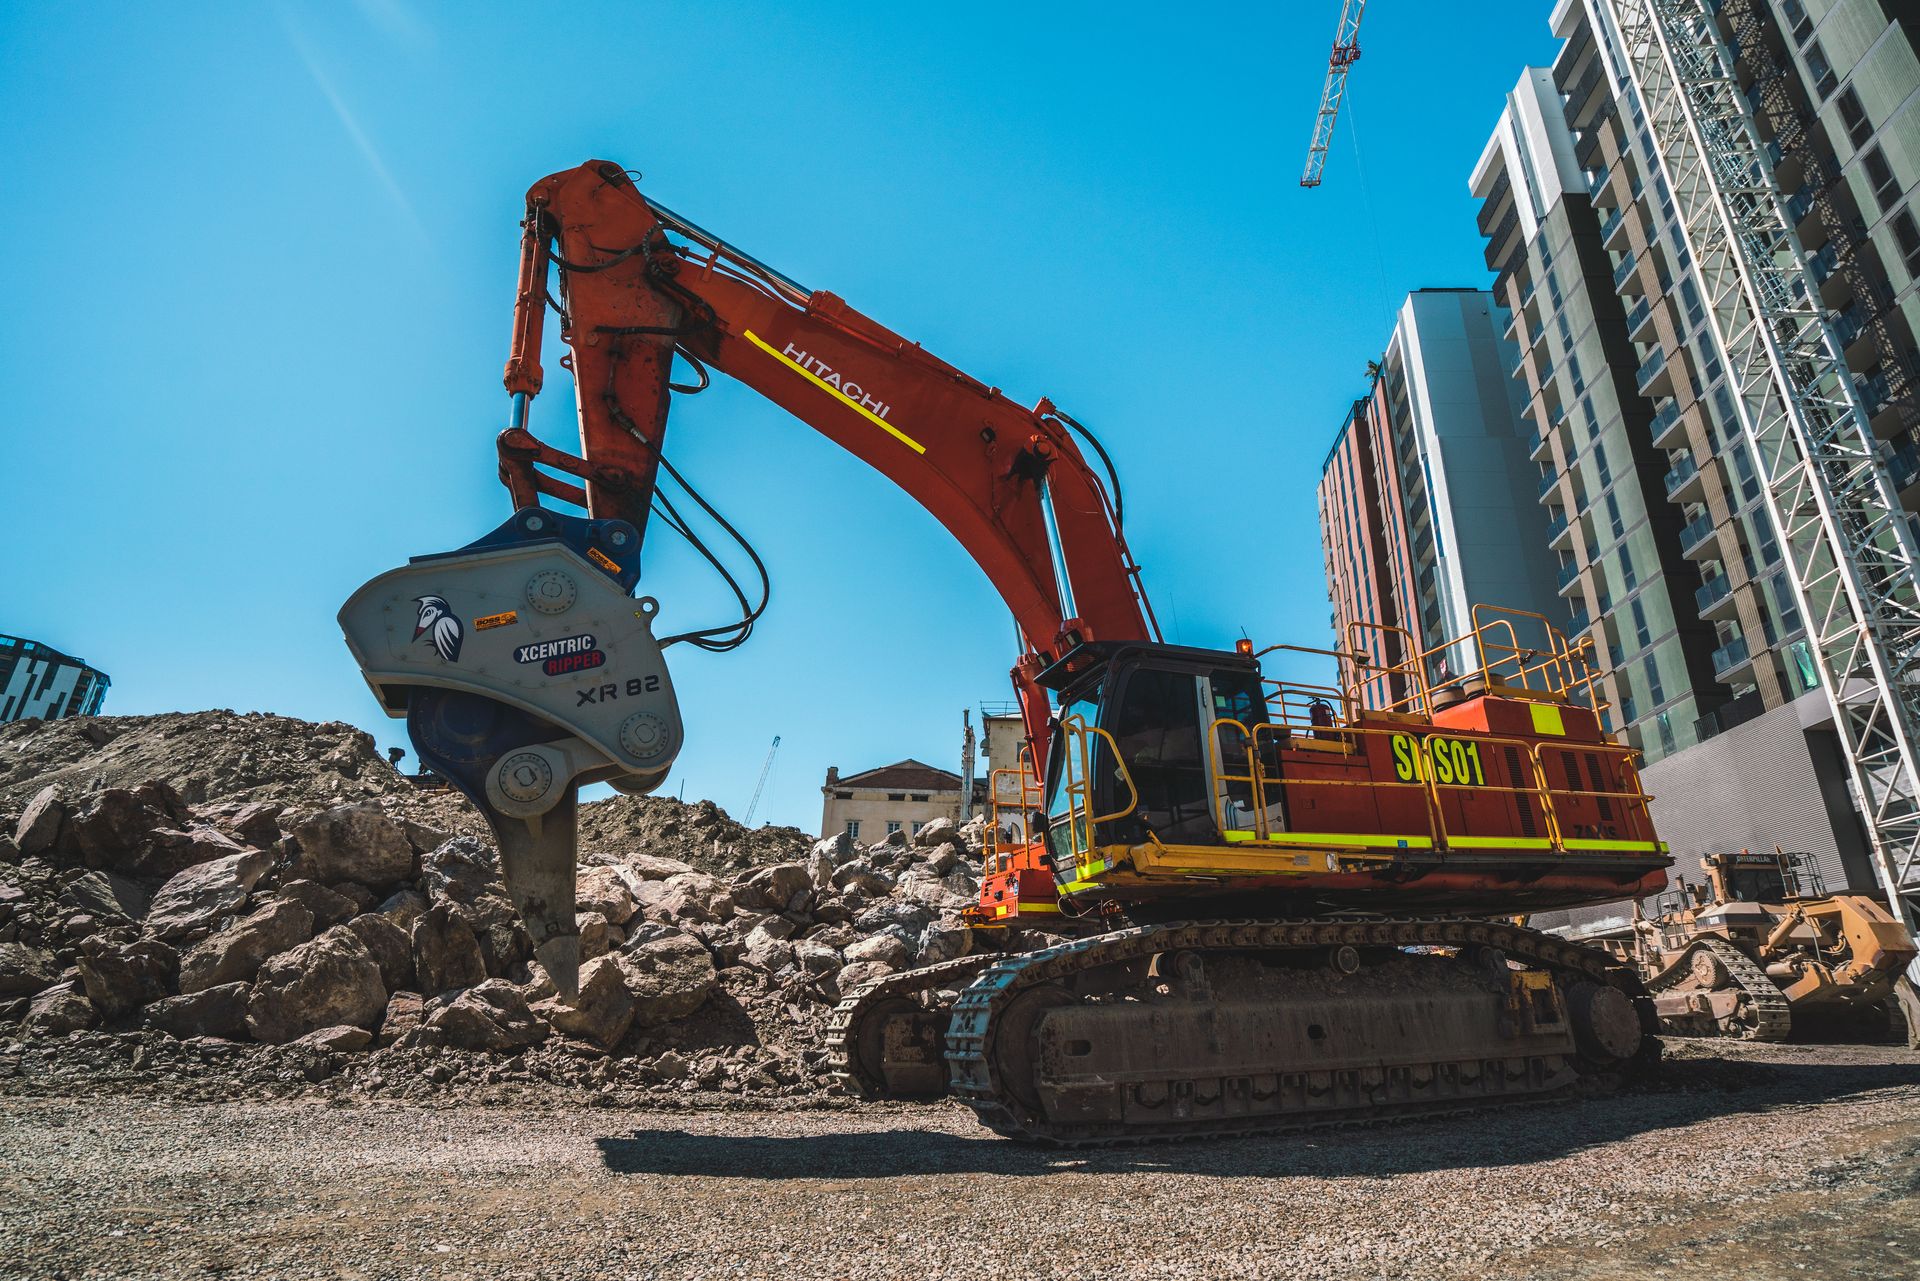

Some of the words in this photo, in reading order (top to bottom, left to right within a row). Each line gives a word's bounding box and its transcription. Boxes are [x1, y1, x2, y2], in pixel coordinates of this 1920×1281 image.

[782, 342, 890, 419] HITACHI
[519, 635, 592, 662] XCENTRIC
[548, 652, 602, 674] RIPPER
[576, 683, 618, 707] XR
[626, 675, 661, 697] 82
